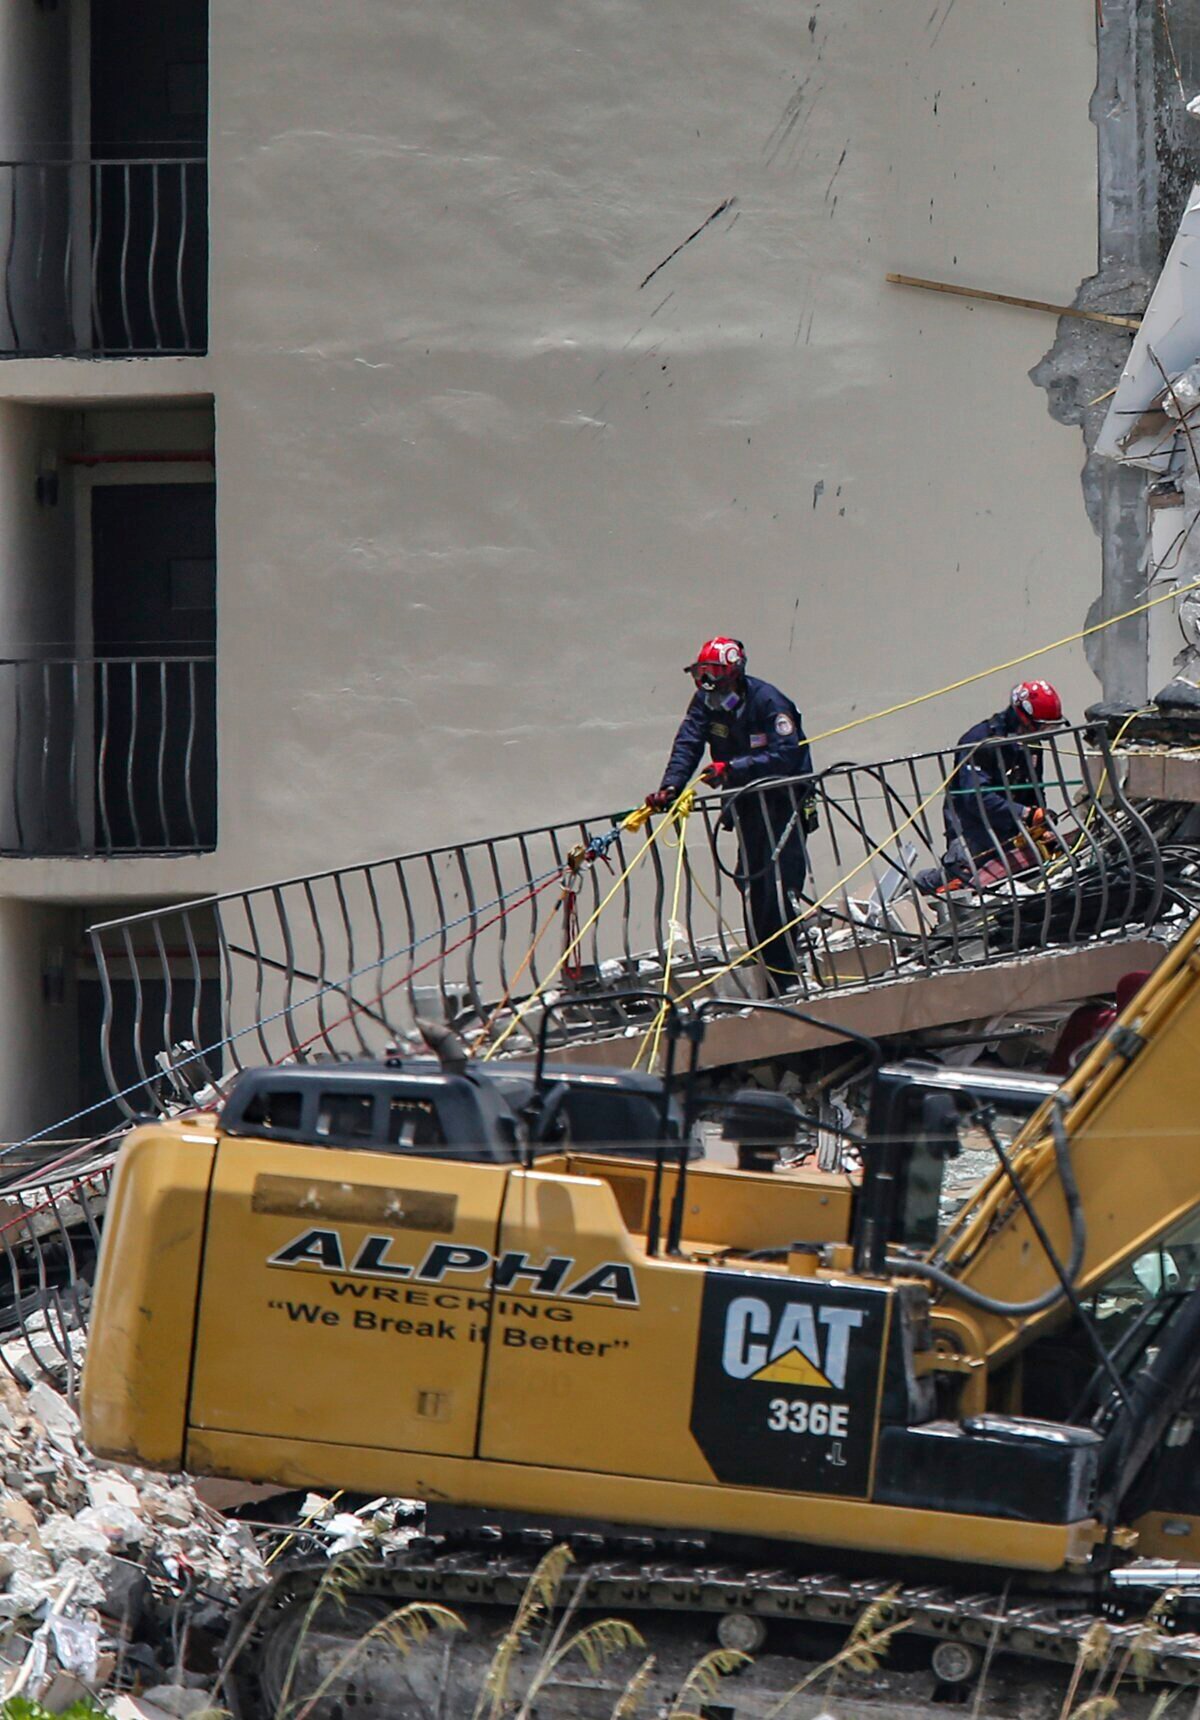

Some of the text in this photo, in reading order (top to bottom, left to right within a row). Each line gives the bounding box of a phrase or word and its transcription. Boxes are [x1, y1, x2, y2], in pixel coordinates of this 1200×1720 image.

[266, 1227, 640, 1306] ALPHA
[329, 1281, 573, 1322] WRECKING
[353, 1310, 457, 1340] Break
[722, 1296, 863, 1390] CAT
[767, 1398, 849, 1438] 336E
